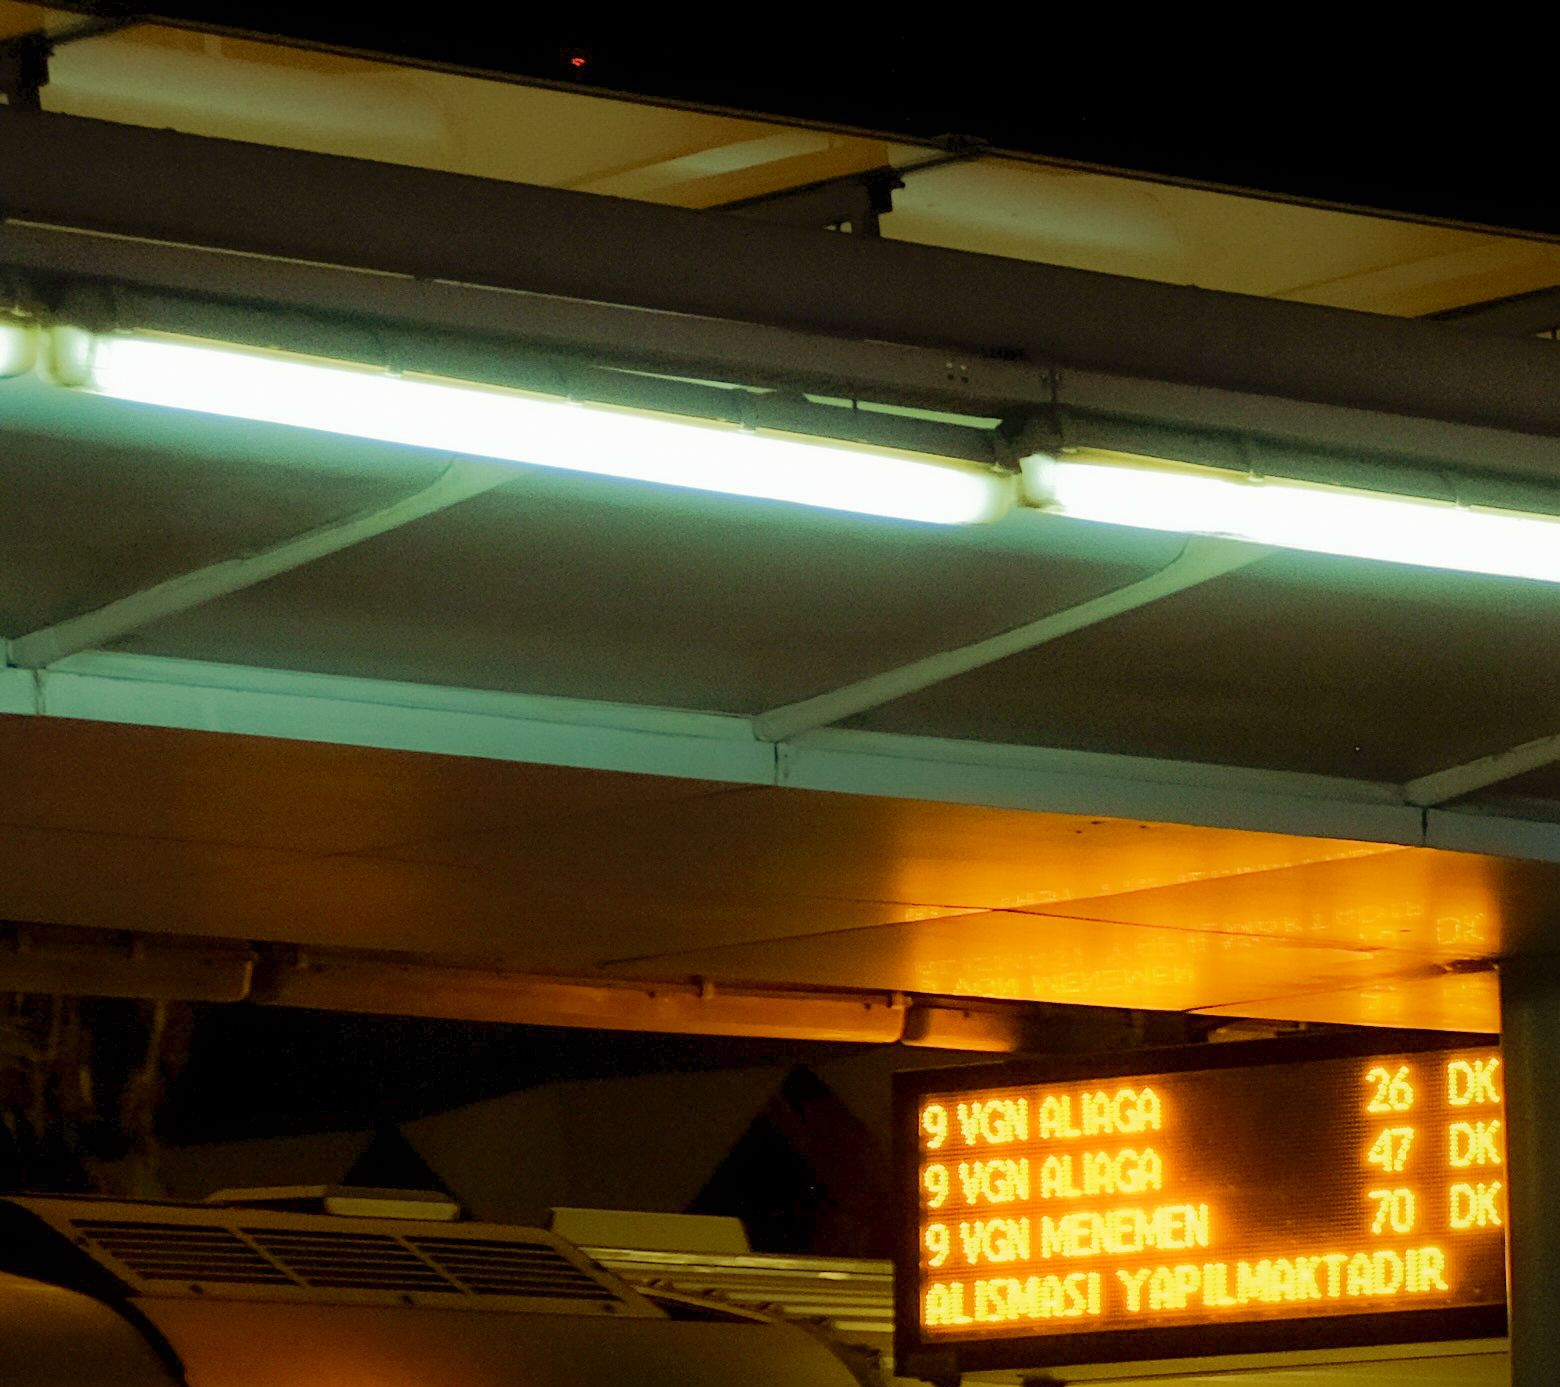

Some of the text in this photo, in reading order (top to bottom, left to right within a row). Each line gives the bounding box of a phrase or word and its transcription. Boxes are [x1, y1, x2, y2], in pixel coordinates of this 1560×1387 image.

[922, 1105, 949, 1149] 9
[957, 1097, 1029, 1146] VGN
[1365, 1065, 1415, 1112] 26
[1447, 1056, 1502, 1105] DK
[923, 1164, 950, 1209] 9
[958, 1158, 1030, 1205] VGN
[1367, 1126, 1415, 1172] 47
[1448, 1119, 1503, 1167] DK
[924, 1180, 1503, 1268] 9 VGN MENEMEN 70 DK
[1115, 1246, 1449, 1313] YAPILMAKTADIR
